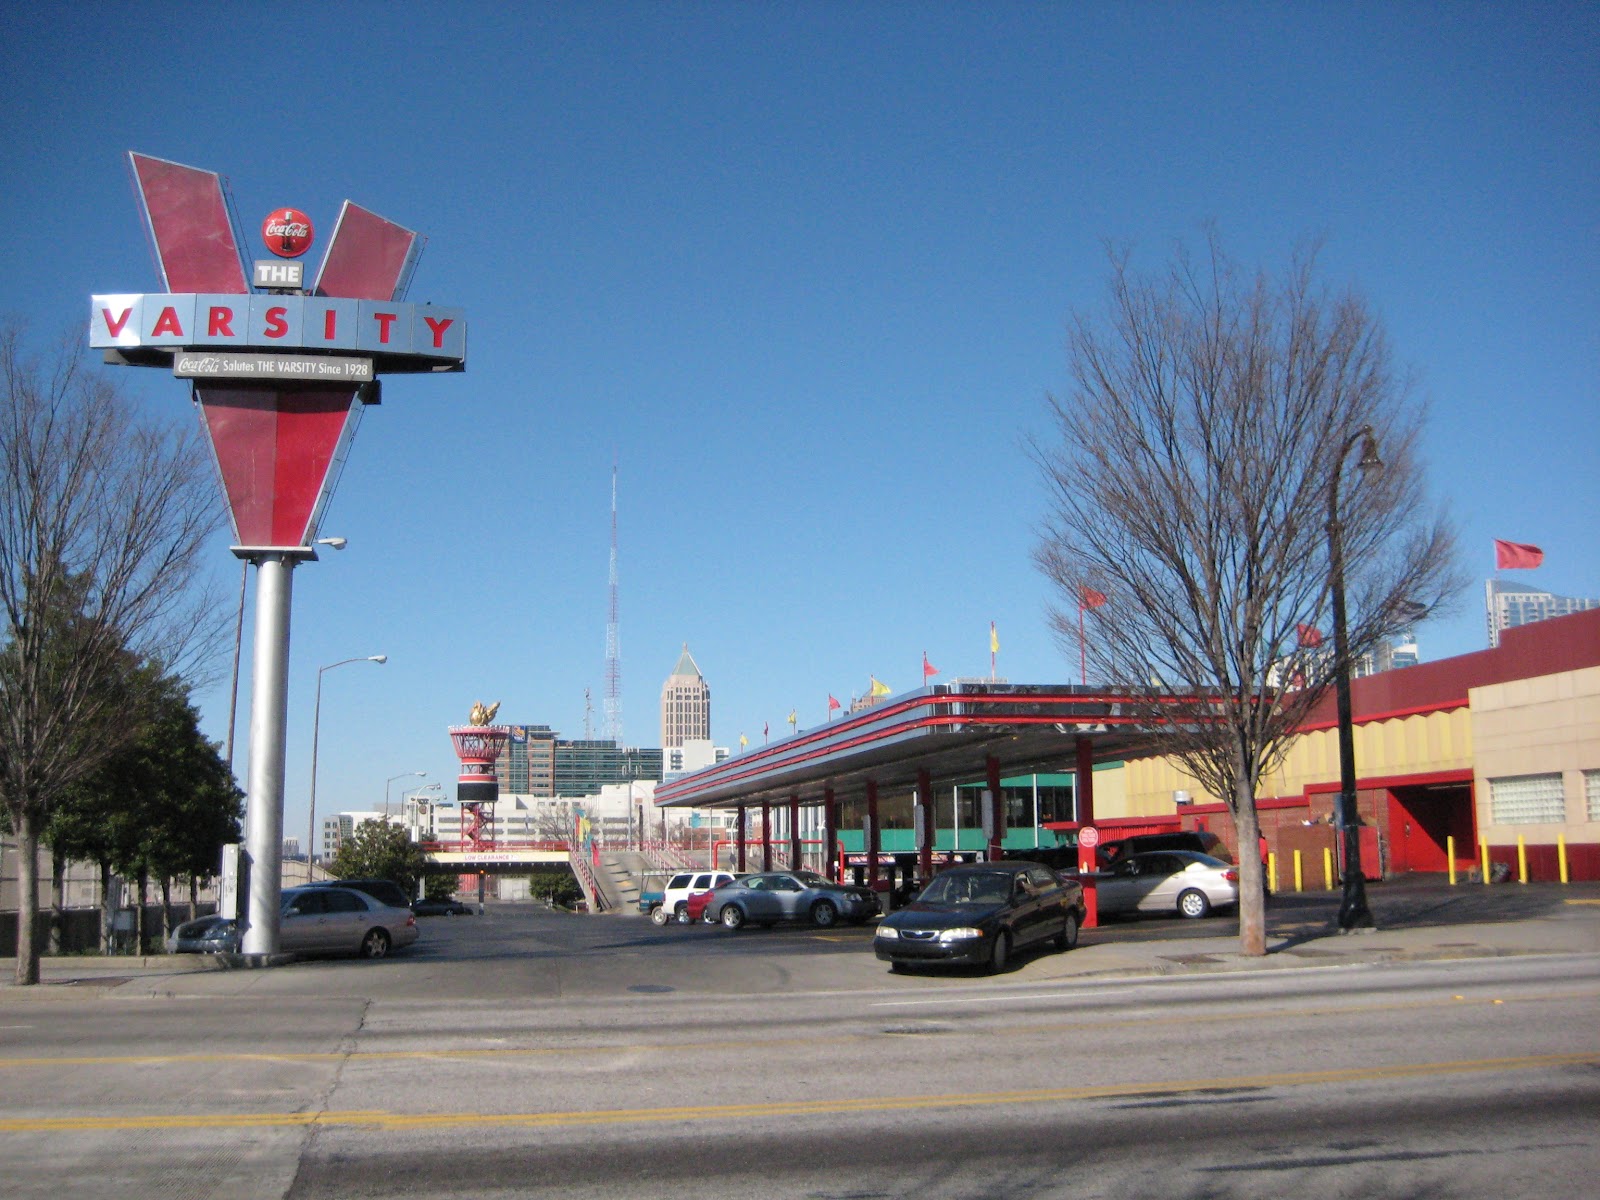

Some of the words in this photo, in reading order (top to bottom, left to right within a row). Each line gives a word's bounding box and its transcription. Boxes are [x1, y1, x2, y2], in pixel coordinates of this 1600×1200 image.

[265, 221, 309, 238] Coca-Cola
[258, 265, 300, 283] THE
[101, 306, 454, 348] VARSITY
[178, 357, 220, 373] Coca-Cola
[223, 360, 254, 372] Salutes
[257, 360, 275, 372] THE
[277, 361, 317, 374] VARSITY
[318, 362, 341, 375] Since
[344, 363, 368, 376] 1928
